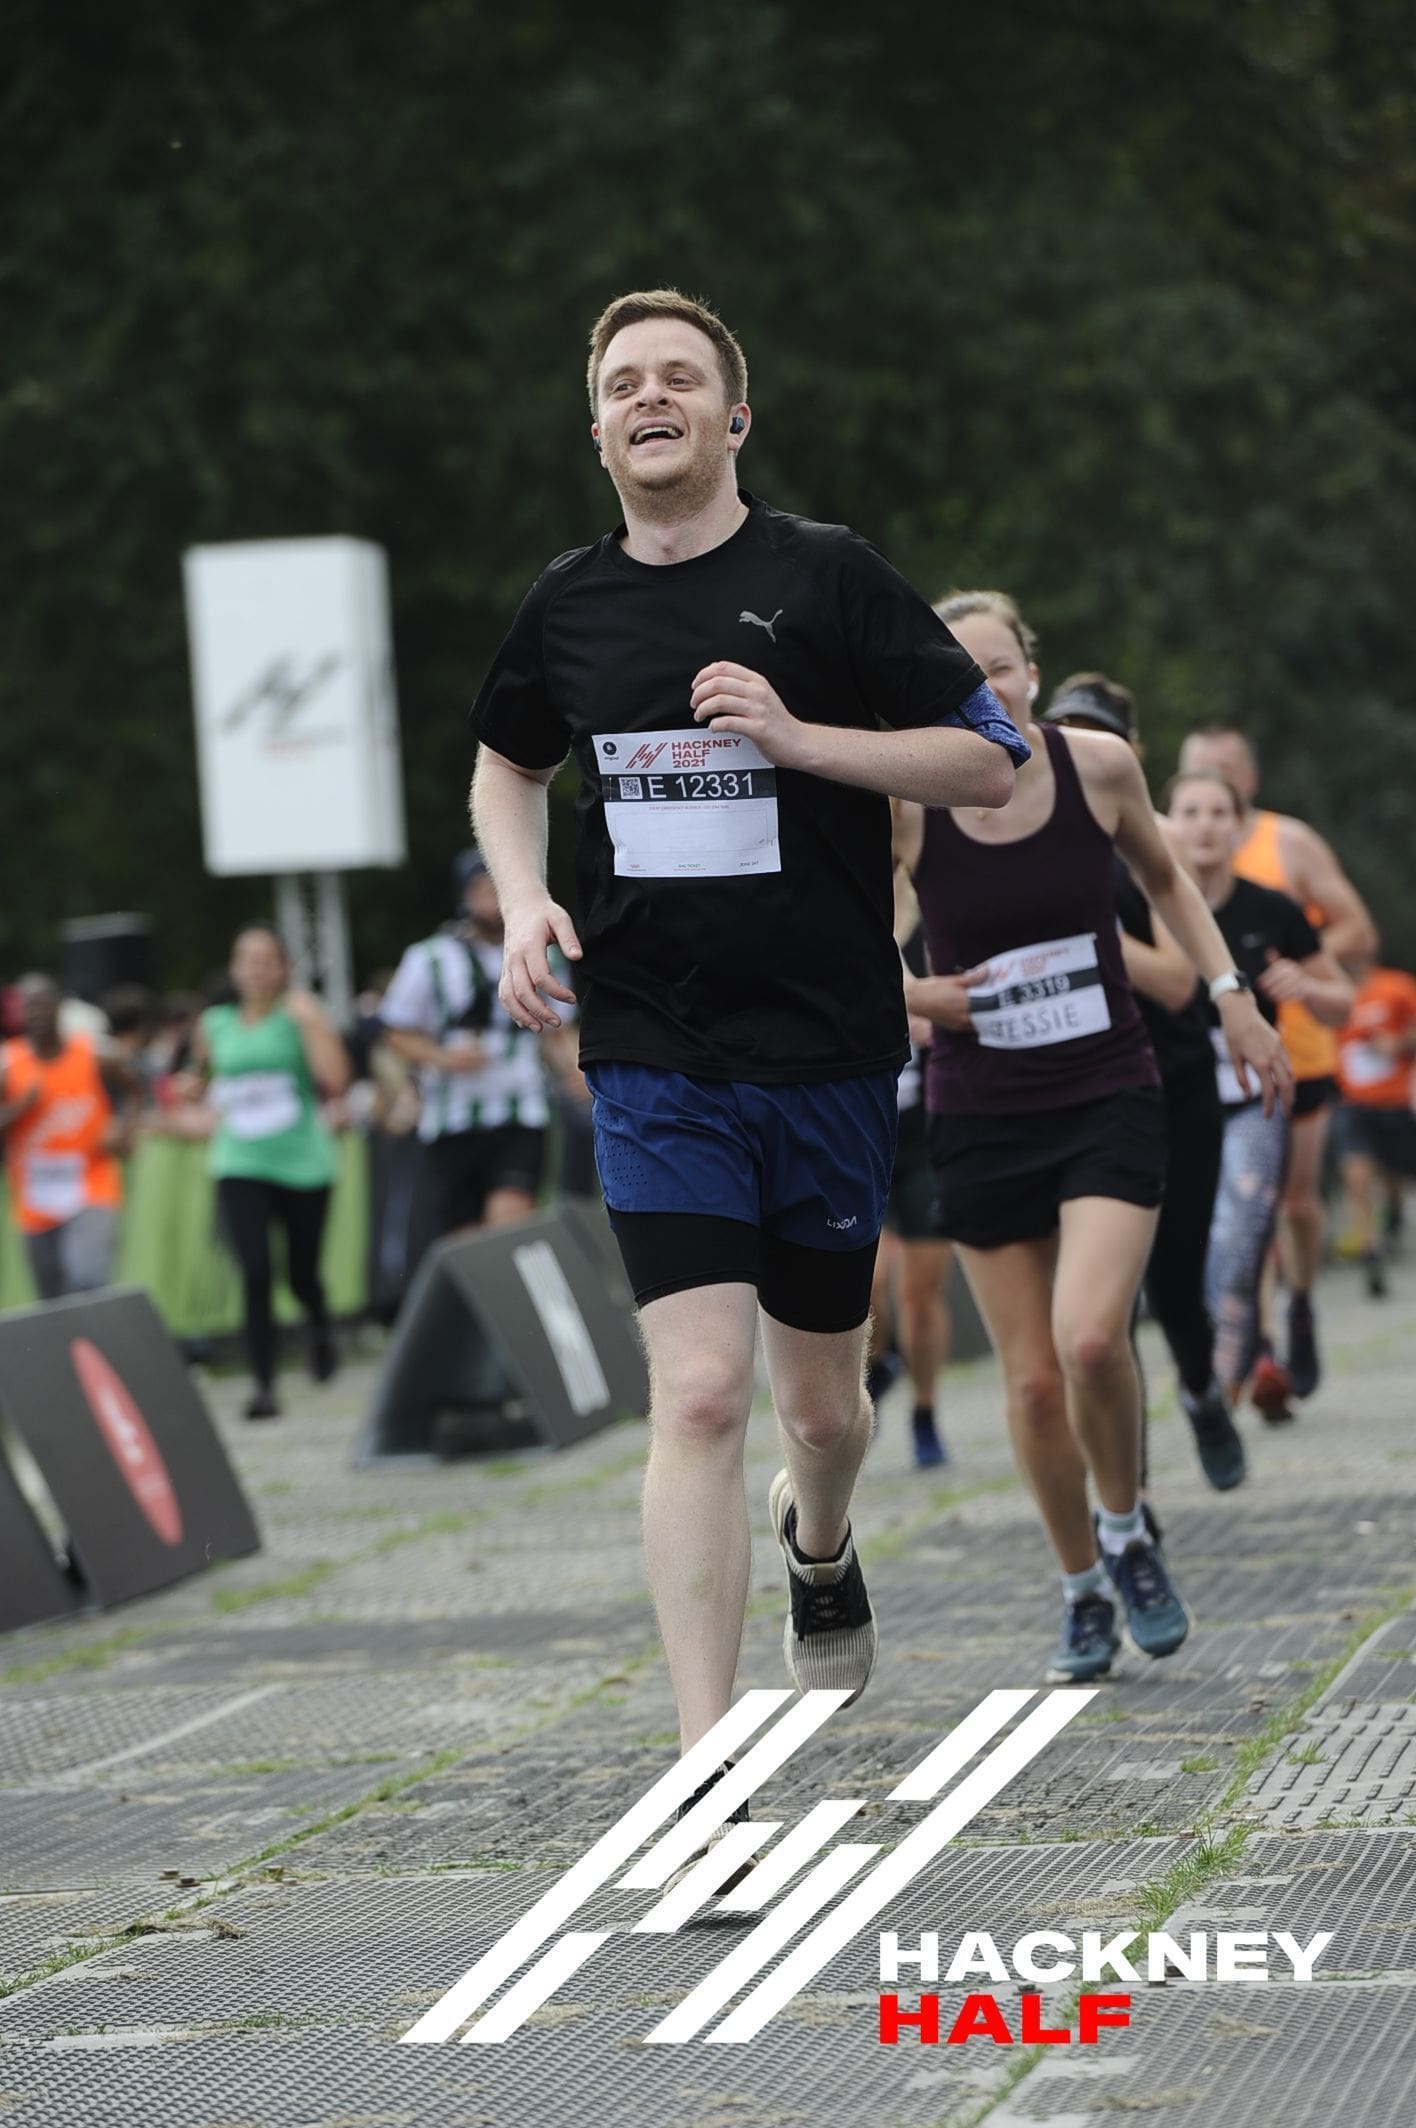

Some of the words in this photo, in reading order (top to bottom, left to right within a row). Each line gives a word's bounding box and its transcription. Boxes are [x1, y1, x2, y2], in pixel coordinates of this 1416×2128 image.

[671, 738, 742, 750] HACKNEY
[672, 749, 710, 760] HALF
[672, 758, 706, 768] 2021
[647, 776, 667, 799] E
[675, 772, 753, 798] 12331
